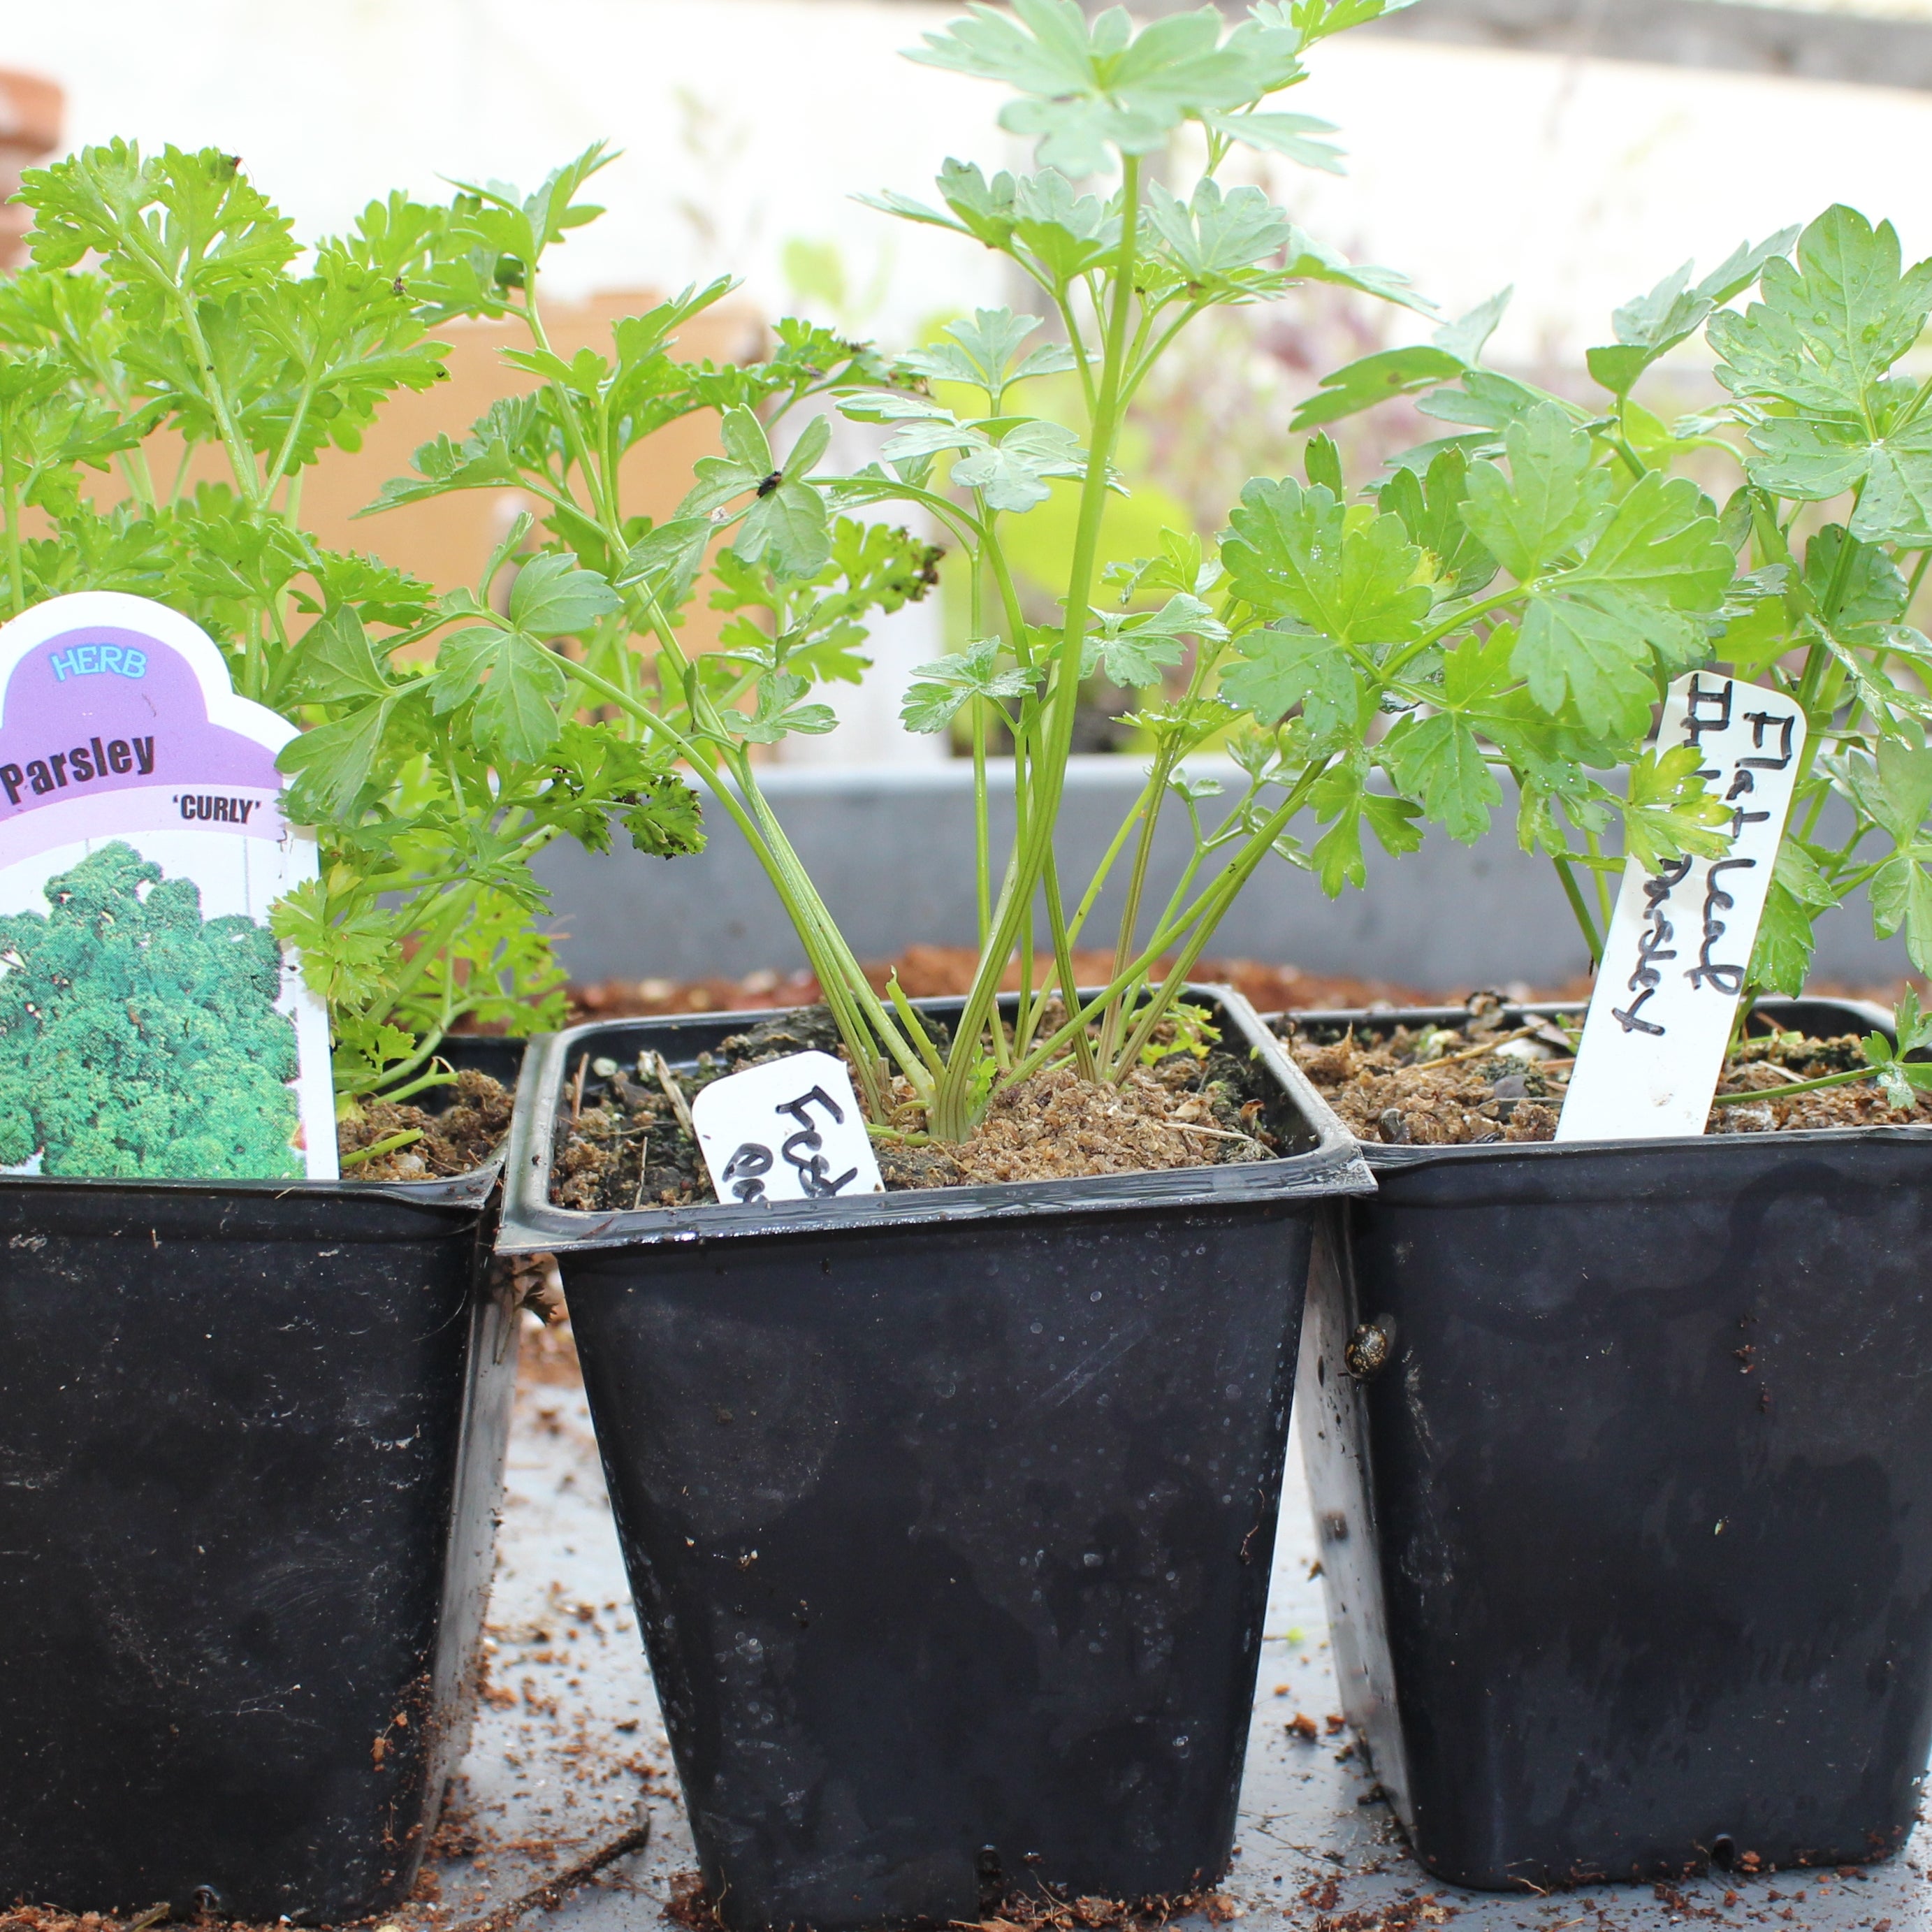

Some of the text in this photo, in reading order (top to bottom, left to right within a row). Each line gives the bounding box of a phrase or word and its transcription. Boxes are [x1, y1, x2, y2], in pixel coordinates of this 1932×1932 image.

[50, 644, 147, 681] HERB
[0, 736, 154, 805] Parsley
[1725, 711, 1795, 839] Flat
